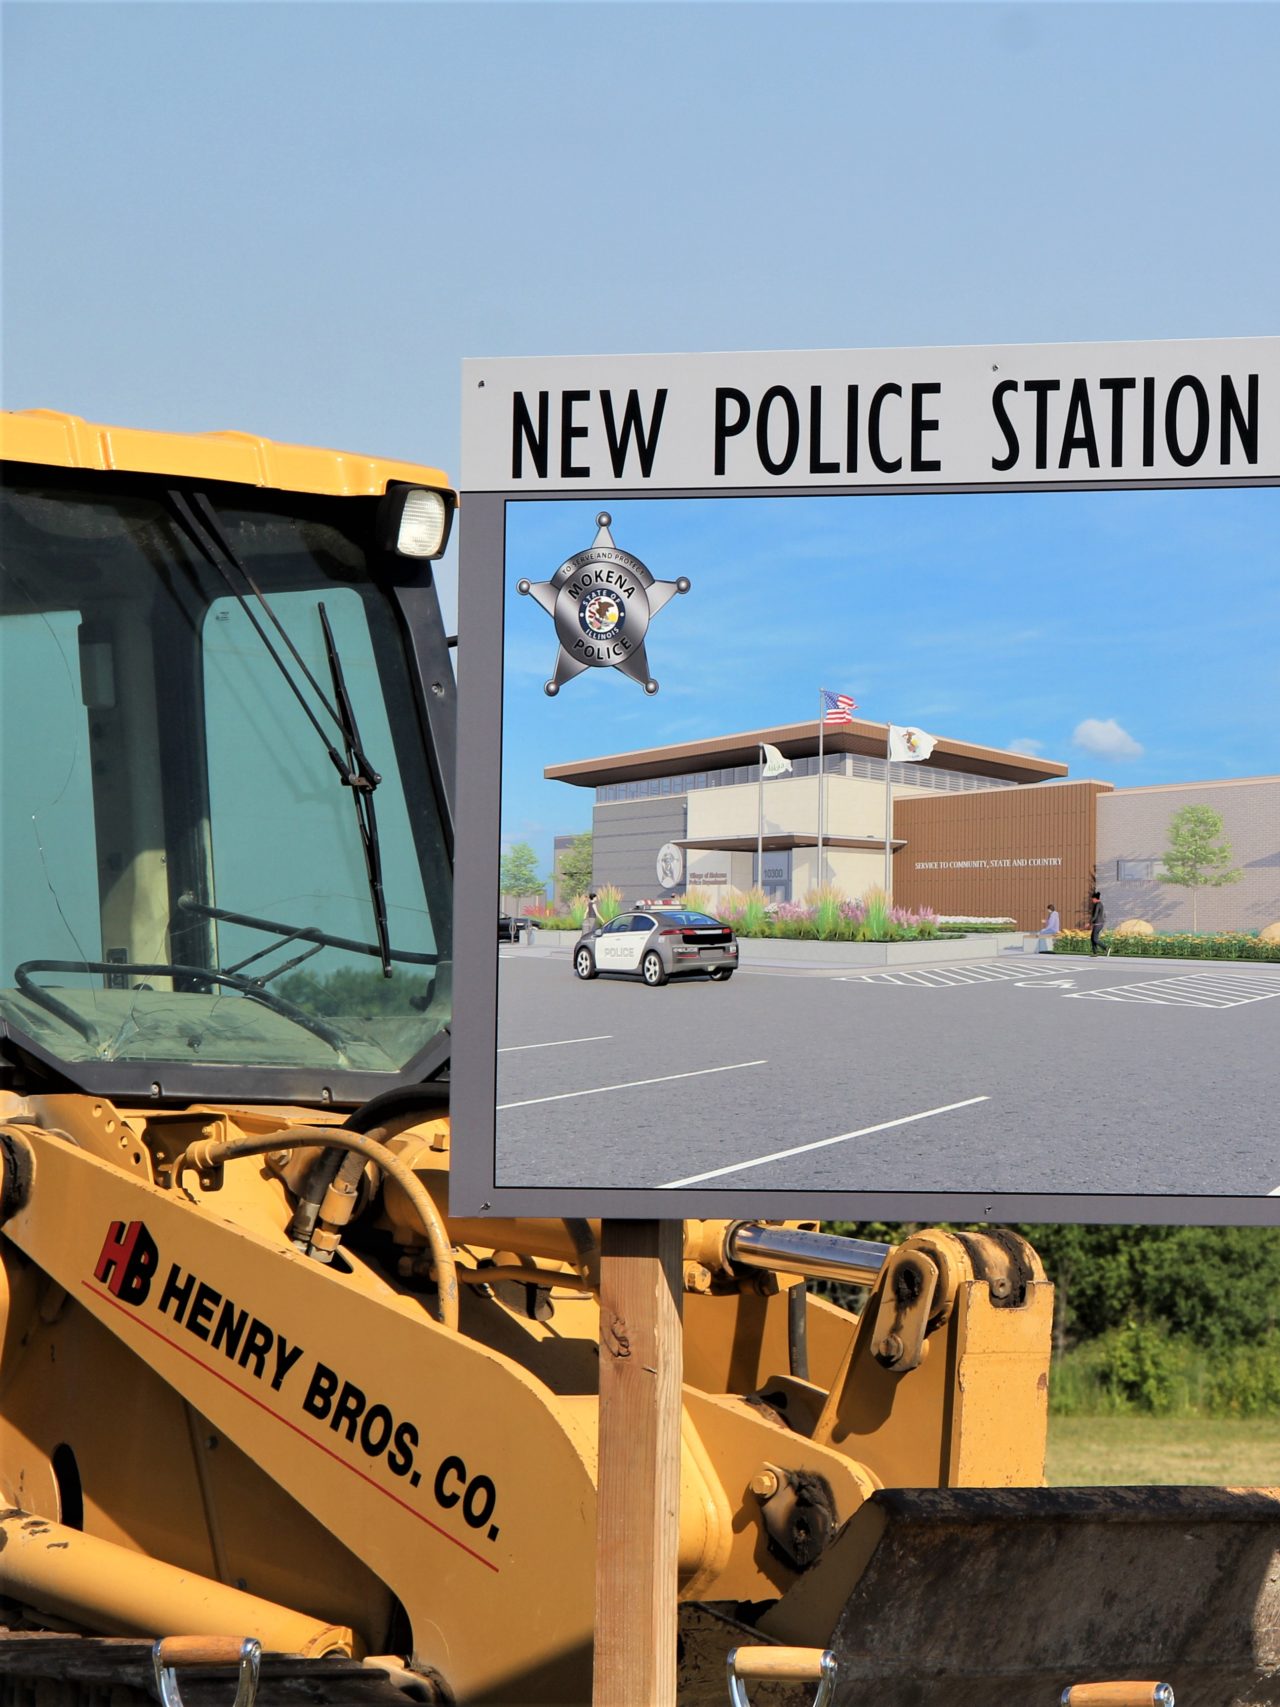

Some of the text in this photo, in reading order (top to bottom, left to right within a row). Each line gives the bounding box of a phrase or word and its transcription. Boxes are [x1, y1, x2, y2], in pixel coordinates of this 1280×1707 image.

[512, 374, 1259, 479] NEW POLICE STATION
[562, 565, 572, 575] TO
[573, 553, 594, 567] SERVE
[615, 553, 645, 576] PROTECT
[568, 569, 636, 600] MOKENA
[583, 589, 620, 606] STATE OF
[585, 627, 619, 640] ILLINOIS
[573, 637, 632, 660] POLICE
[940, 861, 948, 869] TO
[990, 859, 1012, 867] STATE
[1012, 859, 1027, 867] AND
[1028, 857, 1062, 866] COUNTRY
[604, 947, 635, 958] POLICE
[93, 1221, 159, 1307] HB
[157, 1263, 500, 1542] HENRY BROS. CO.
